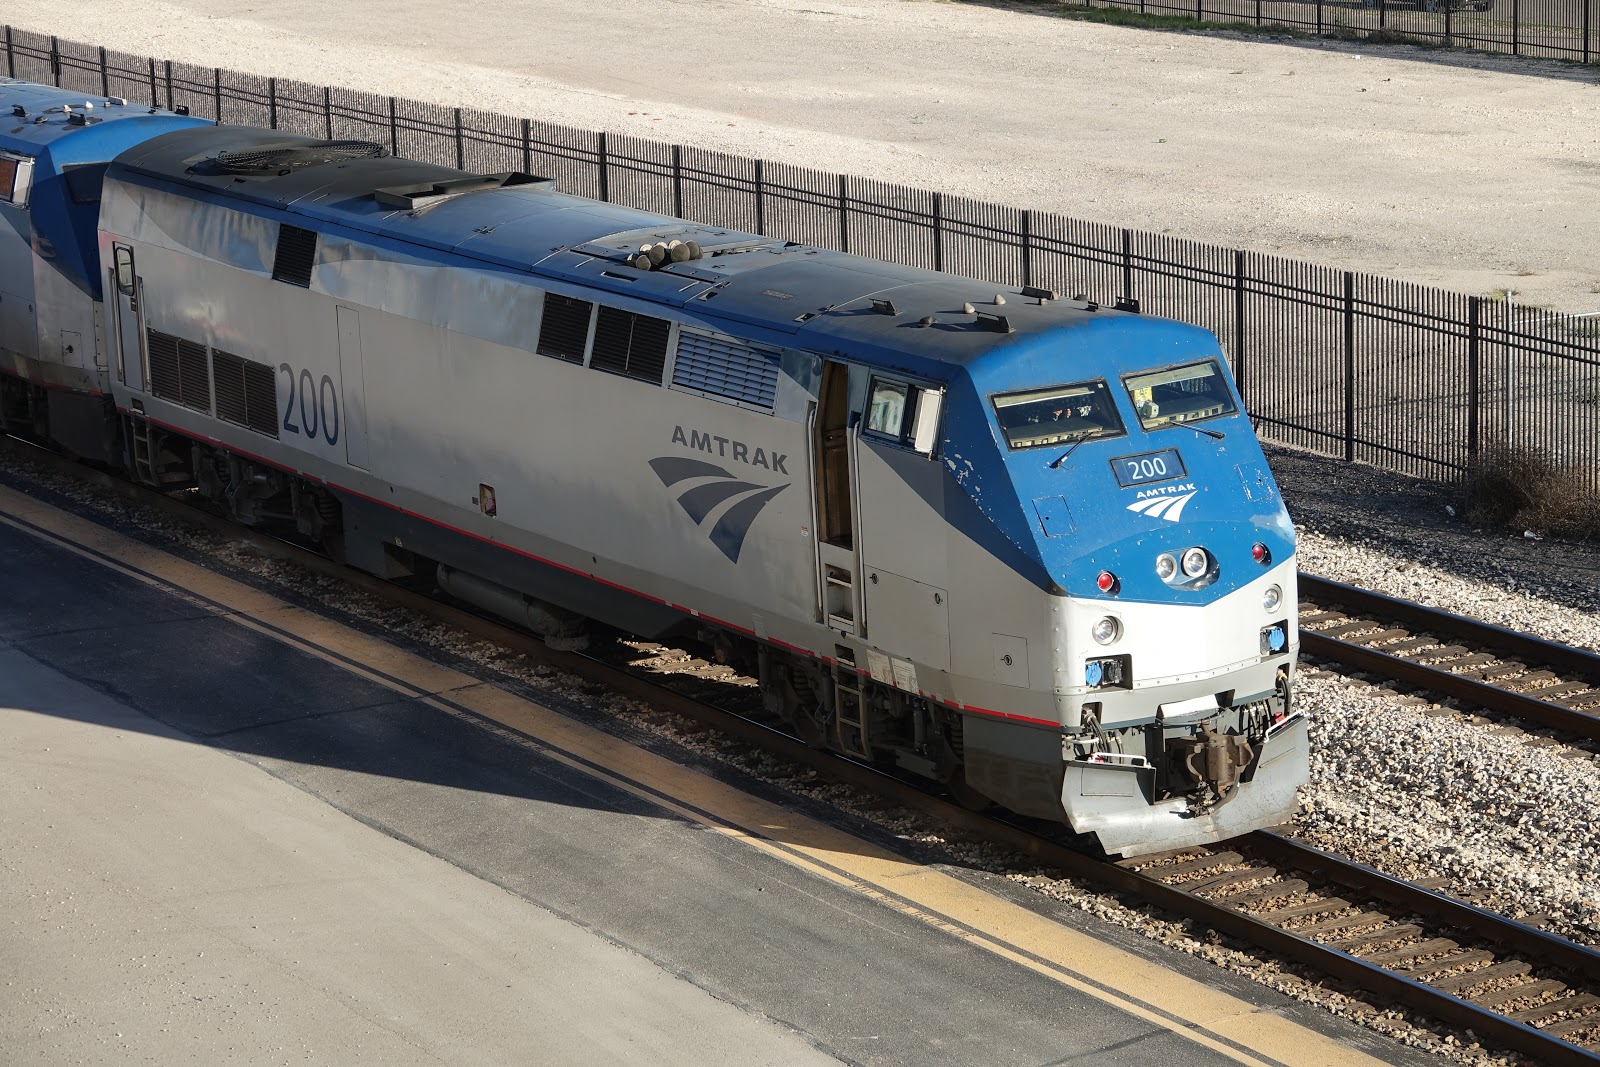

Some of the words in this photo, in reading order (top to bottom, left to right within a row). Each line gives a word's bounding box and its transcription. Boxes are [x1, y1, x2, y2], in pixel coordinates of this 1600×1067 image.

[279, 363, 339, 446] 200
[671, 425, 789, 475] AMTRAK
[1127, 457, 1167, 480] 200
[1136, 483, 1197, 500] AMTRAK
